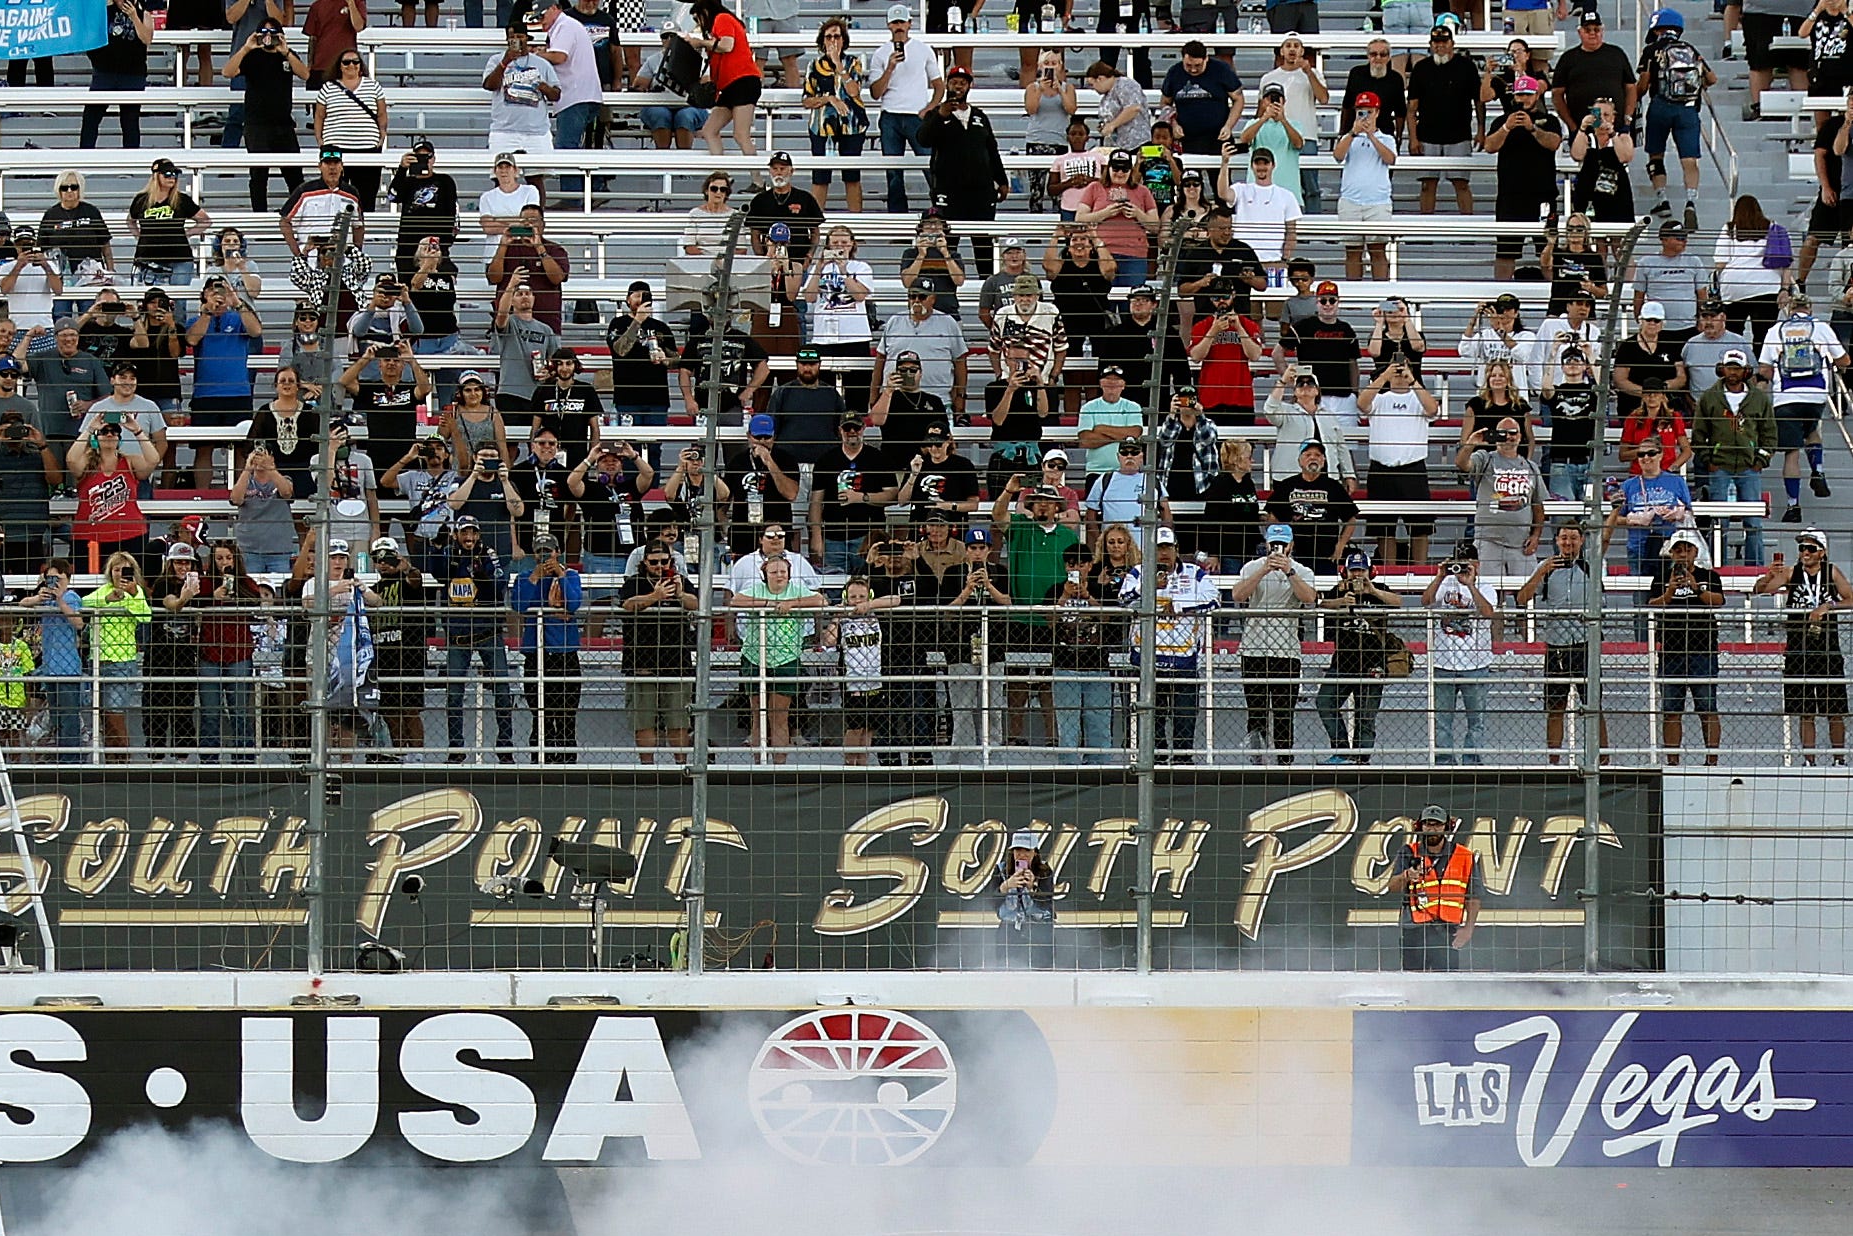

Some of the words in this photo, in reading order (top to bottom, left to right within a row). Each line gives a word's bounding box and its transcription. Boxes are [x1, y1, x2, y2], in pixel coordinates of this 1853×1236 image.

[104, 476, 127, 499] 23
[452, 583, 472, 597] NAPA
[356, 787, 749, 940] POINT
[813, 796, 1212, 935] SOUTH
[1234, 787, 1623, 941] PONT
[240, 1013, 703, 1163] USA
[1416, 1065, 1507, 1126] LAS
[1475, 1012, 1817, 1168] Vegas
